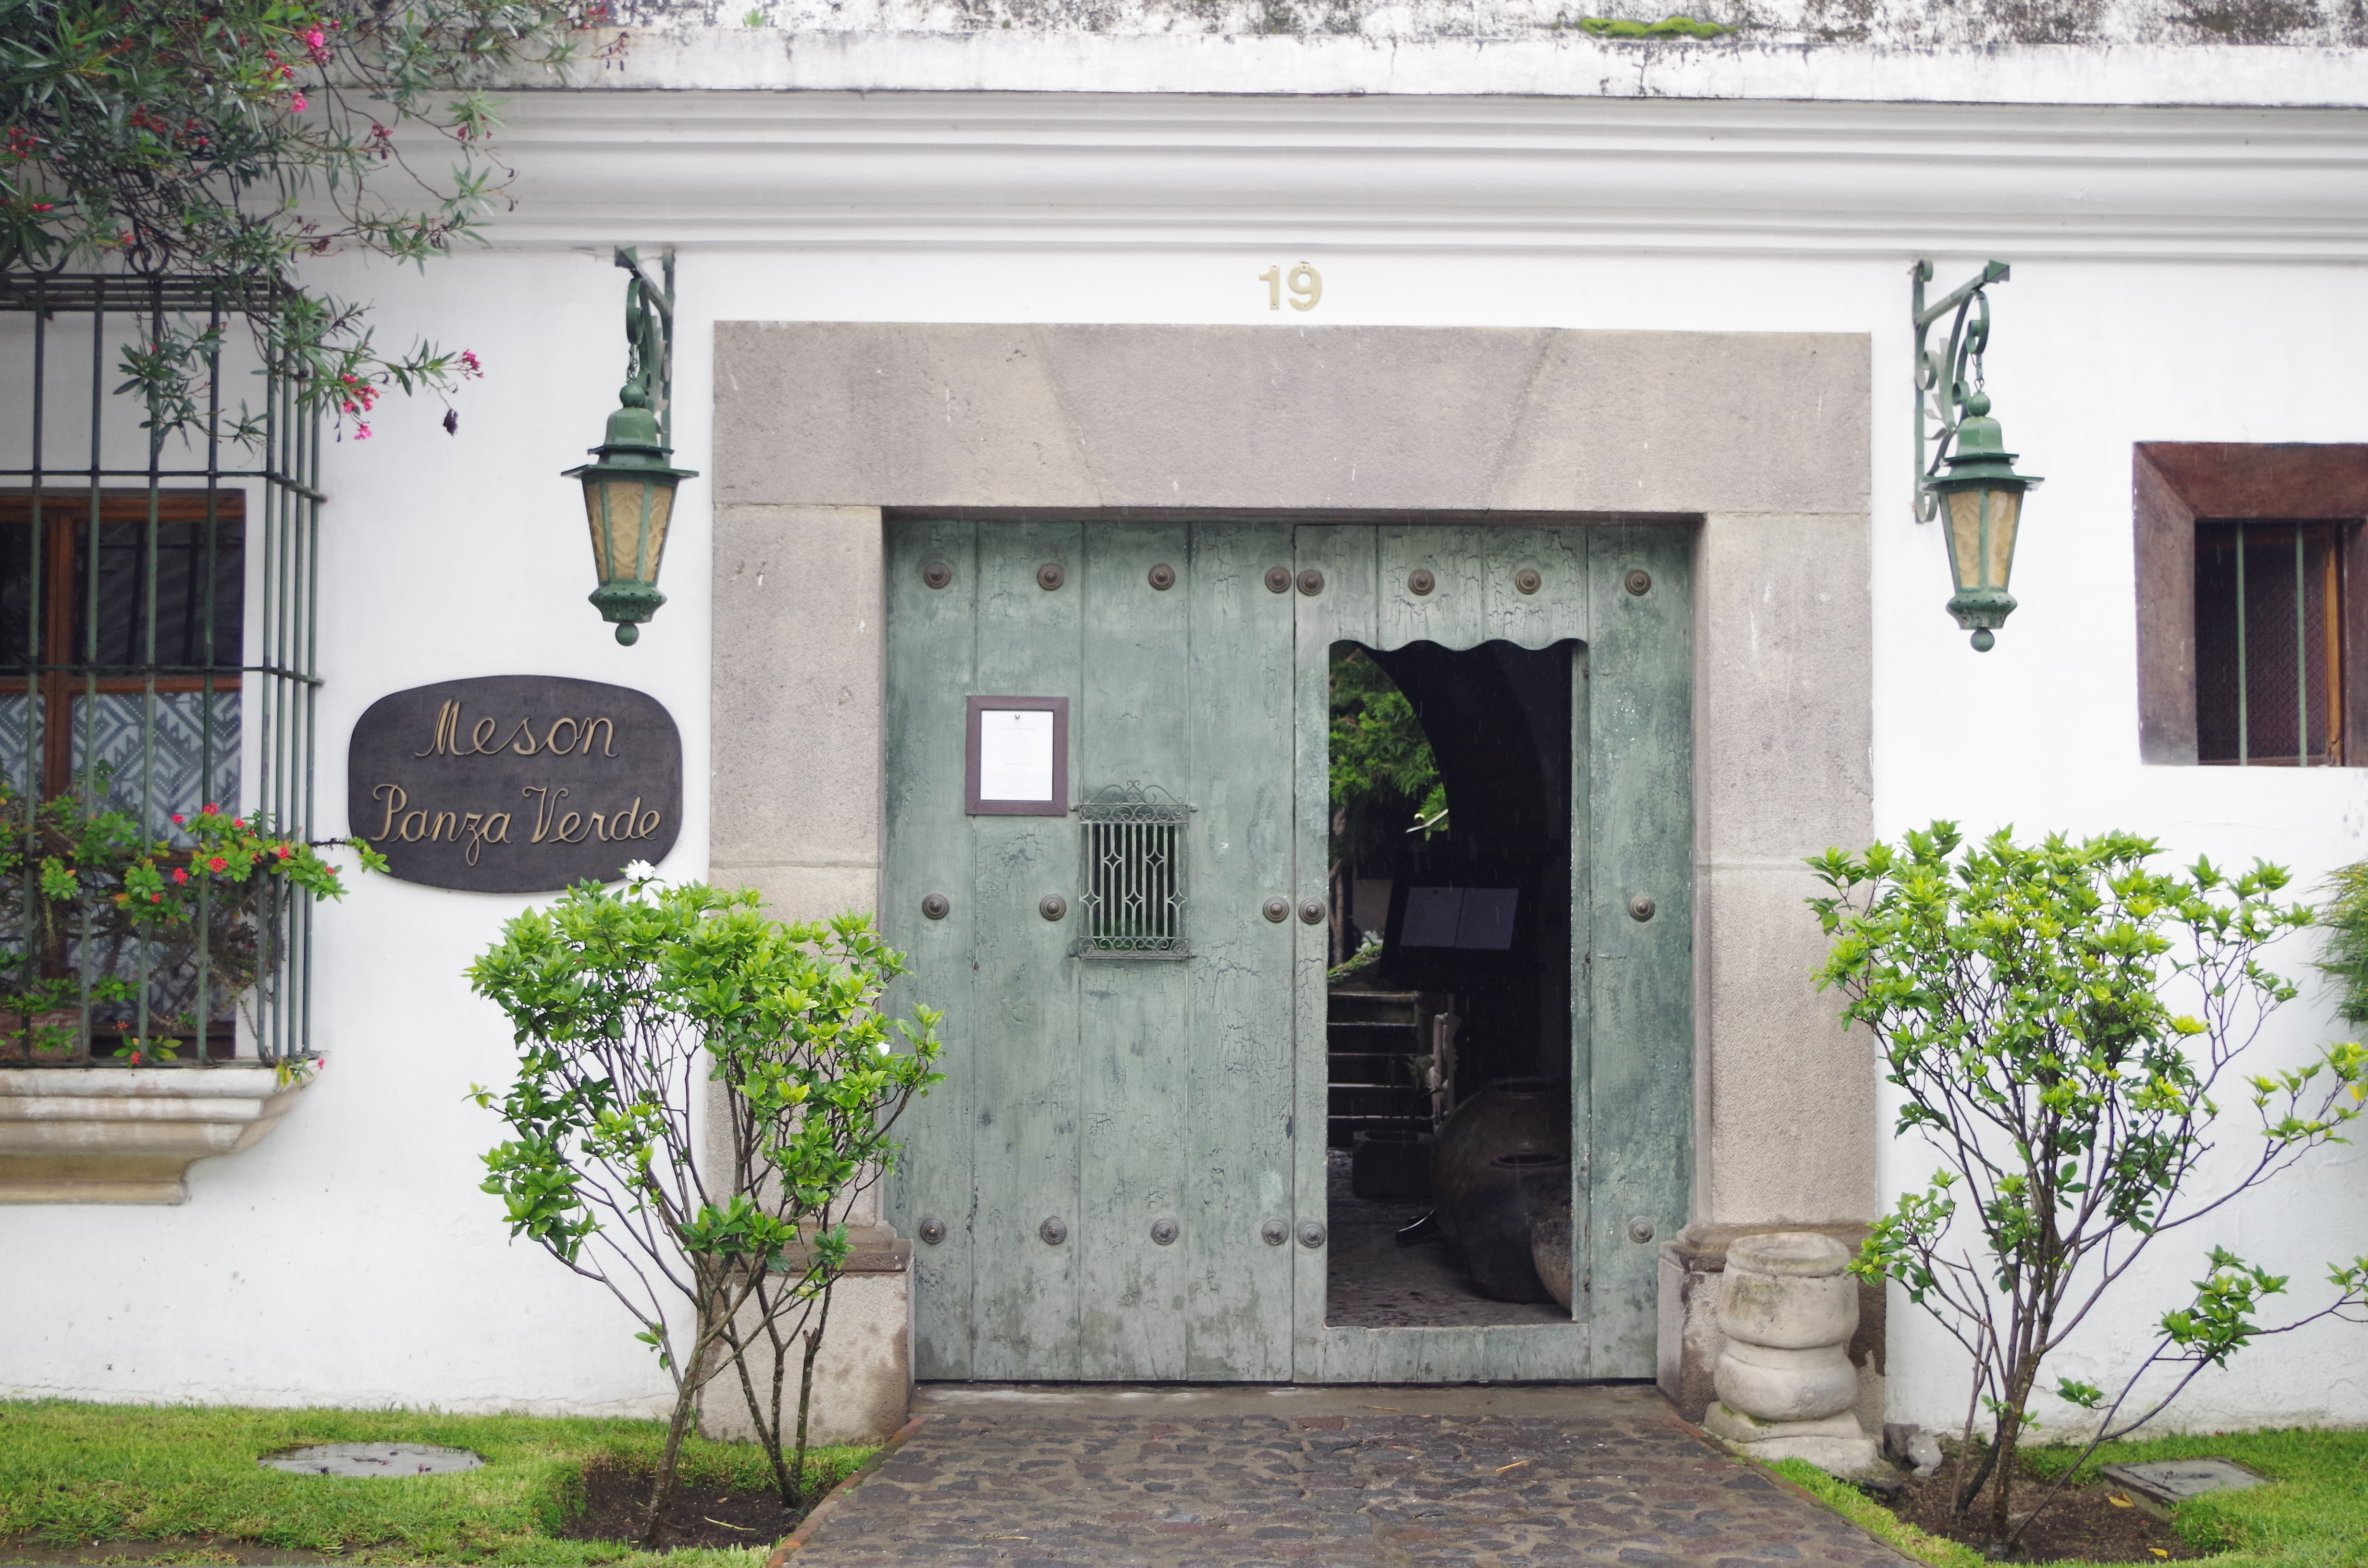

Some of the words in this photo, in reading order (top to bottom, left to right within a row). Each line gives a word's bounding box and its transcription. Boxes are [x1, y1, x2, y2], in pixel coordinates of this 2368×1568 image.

[1259, 263, 1322, 311] 19
[416, 699, 618, 757] Meson
[370, 784, 512, 866] Panza
[522, 786, 661, 843] Verde
